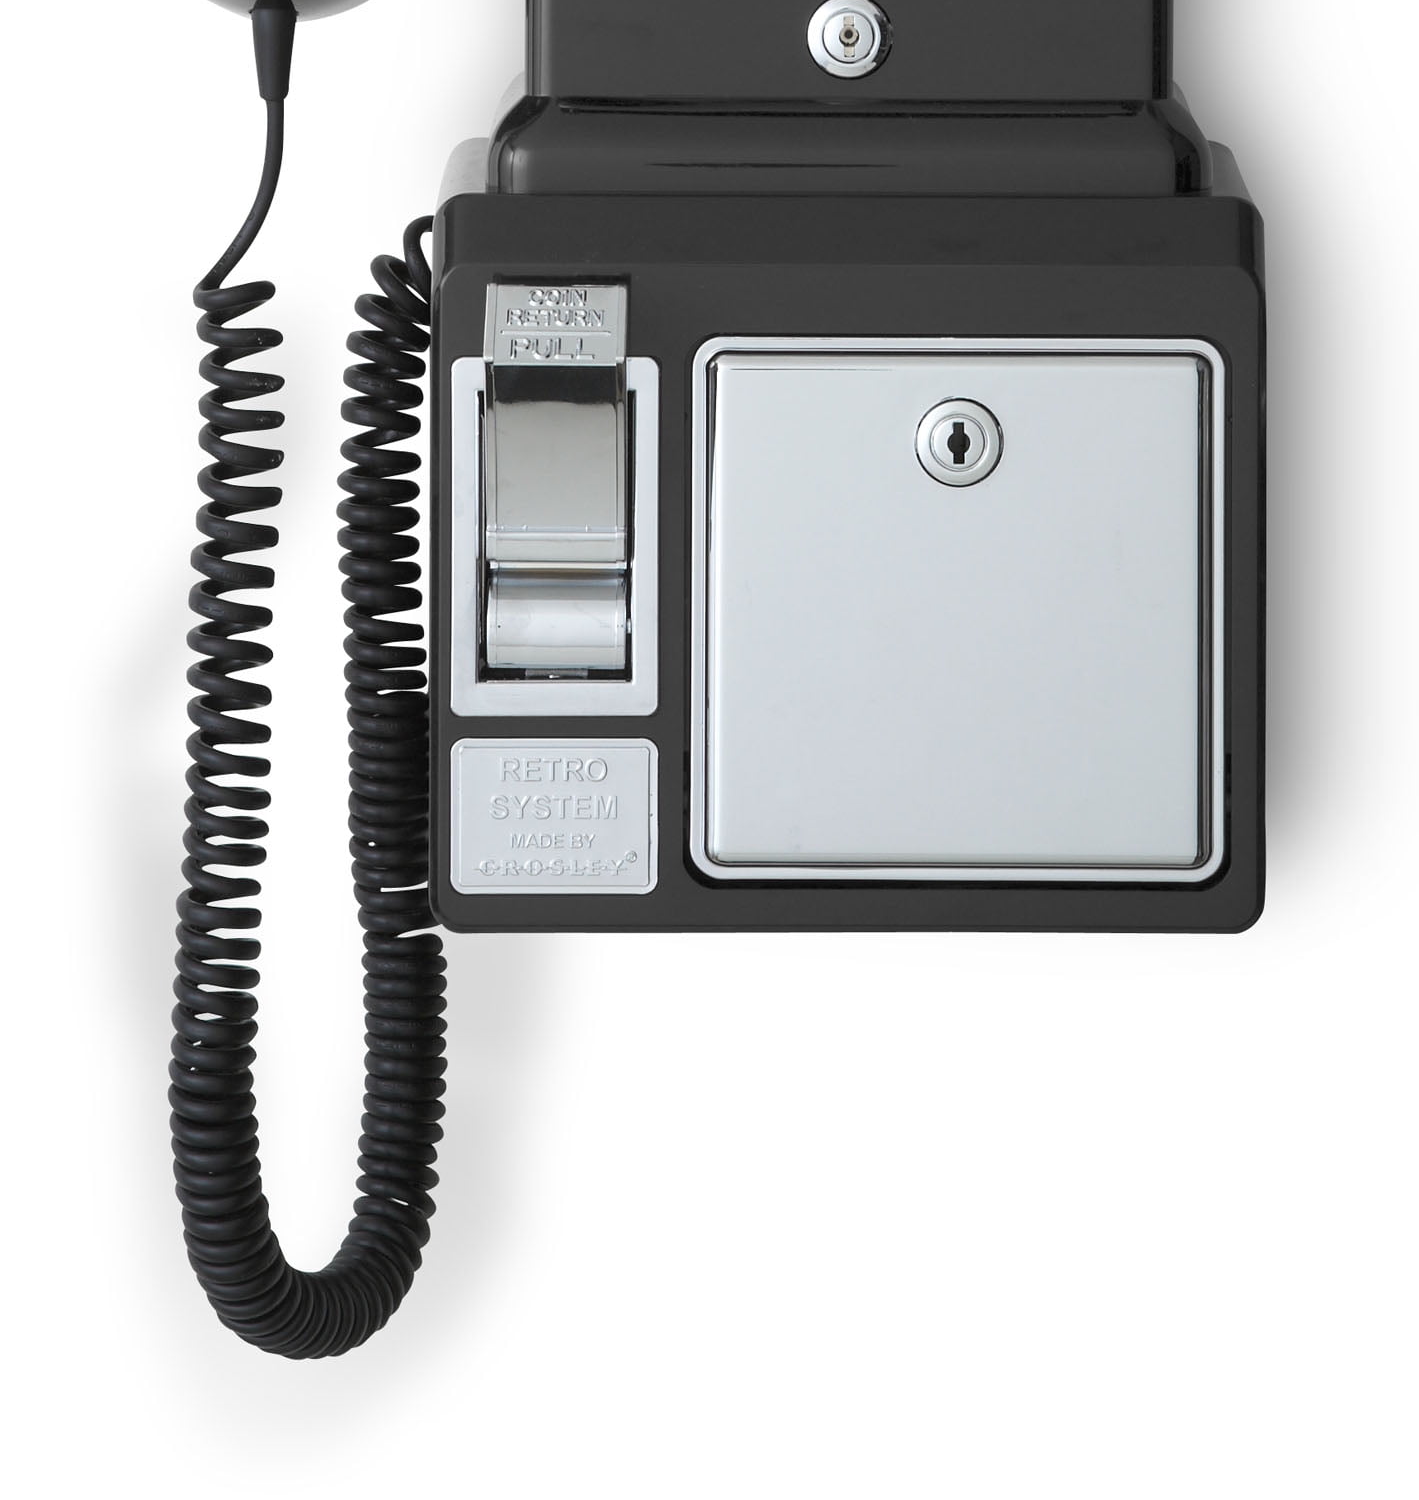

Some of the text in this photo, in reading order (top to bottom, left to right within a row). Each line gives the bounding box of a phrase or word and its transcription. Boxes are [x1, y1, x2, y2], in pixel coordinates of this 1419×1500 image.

[528, 288, 588, 306] COIN
[507, 308, 605, 327] RETURN
[510, 337, 595, 360] PULL
[501, 757, 608, 782] RETRO
[489, 794, 618, 820] SYSTEM
[510, 833, 596, 849] MADE BY
